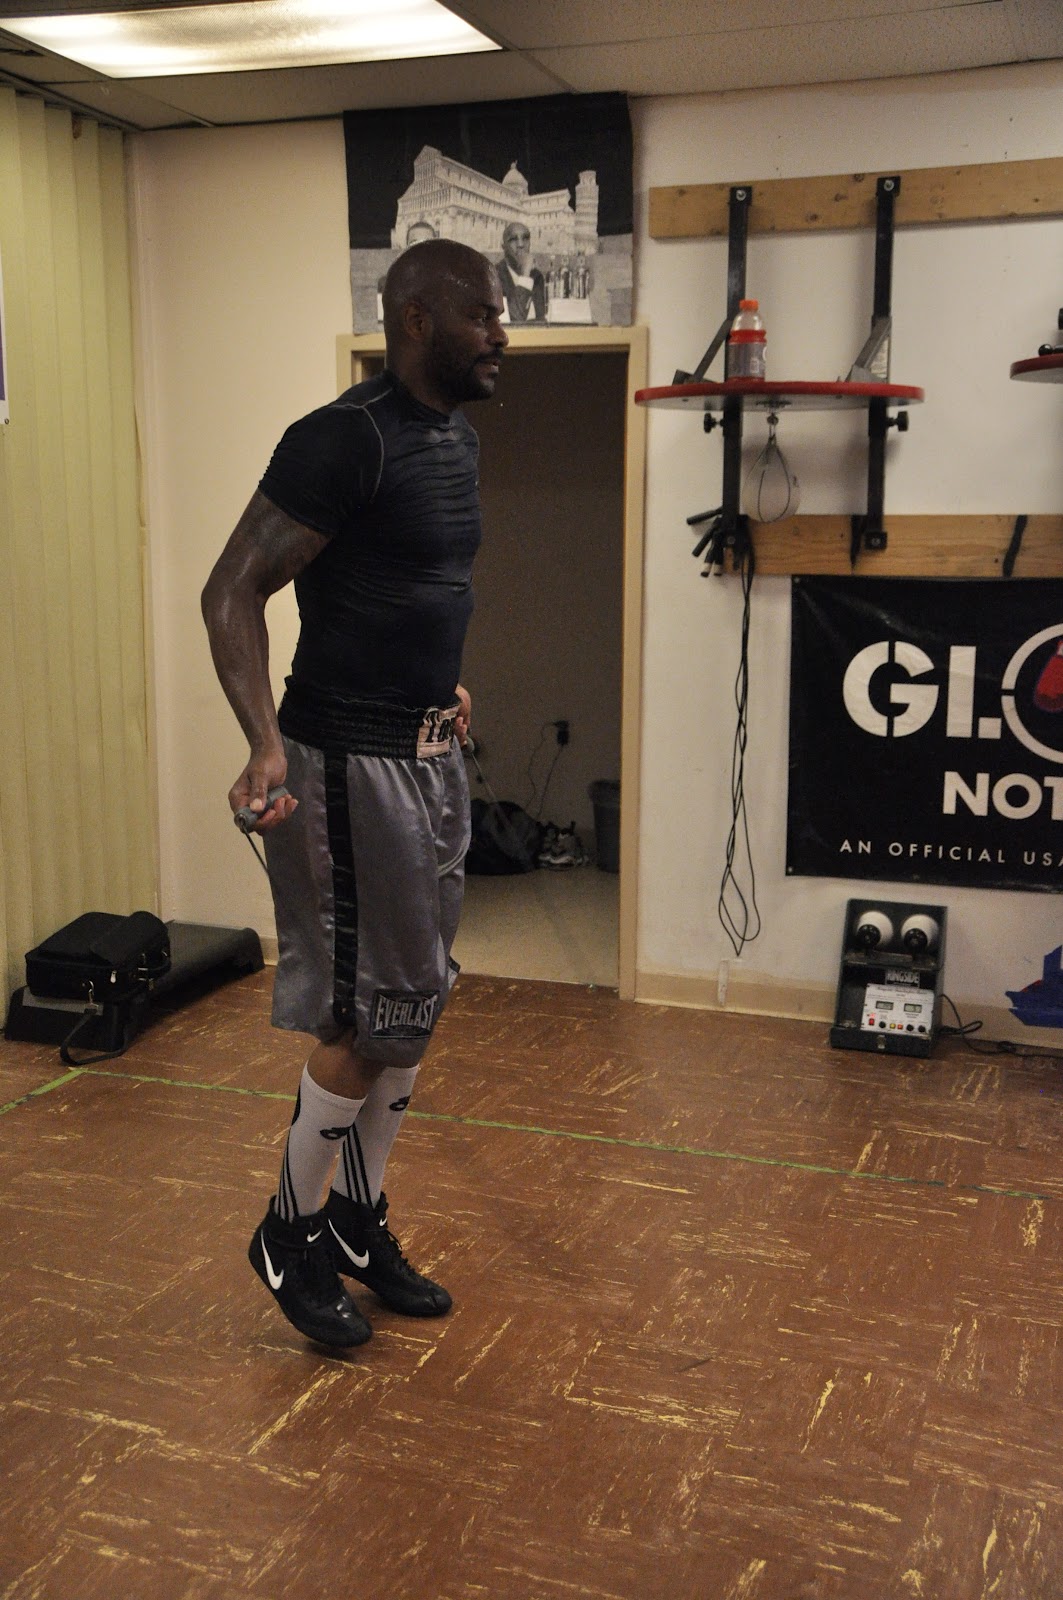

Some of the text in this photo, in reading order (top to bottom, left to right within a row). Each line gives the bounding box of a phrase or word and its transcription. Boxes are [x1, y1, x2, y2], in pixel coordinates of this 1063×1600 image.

[943, 771, 1063, 820] NOT
[840, 839, 871, 854] AN
[888, 842, 1005, 863] OFFICIAL
[887, 969, 920, 983] RINGSIDE
[374, 994, 438, 1031] EVERLAST
